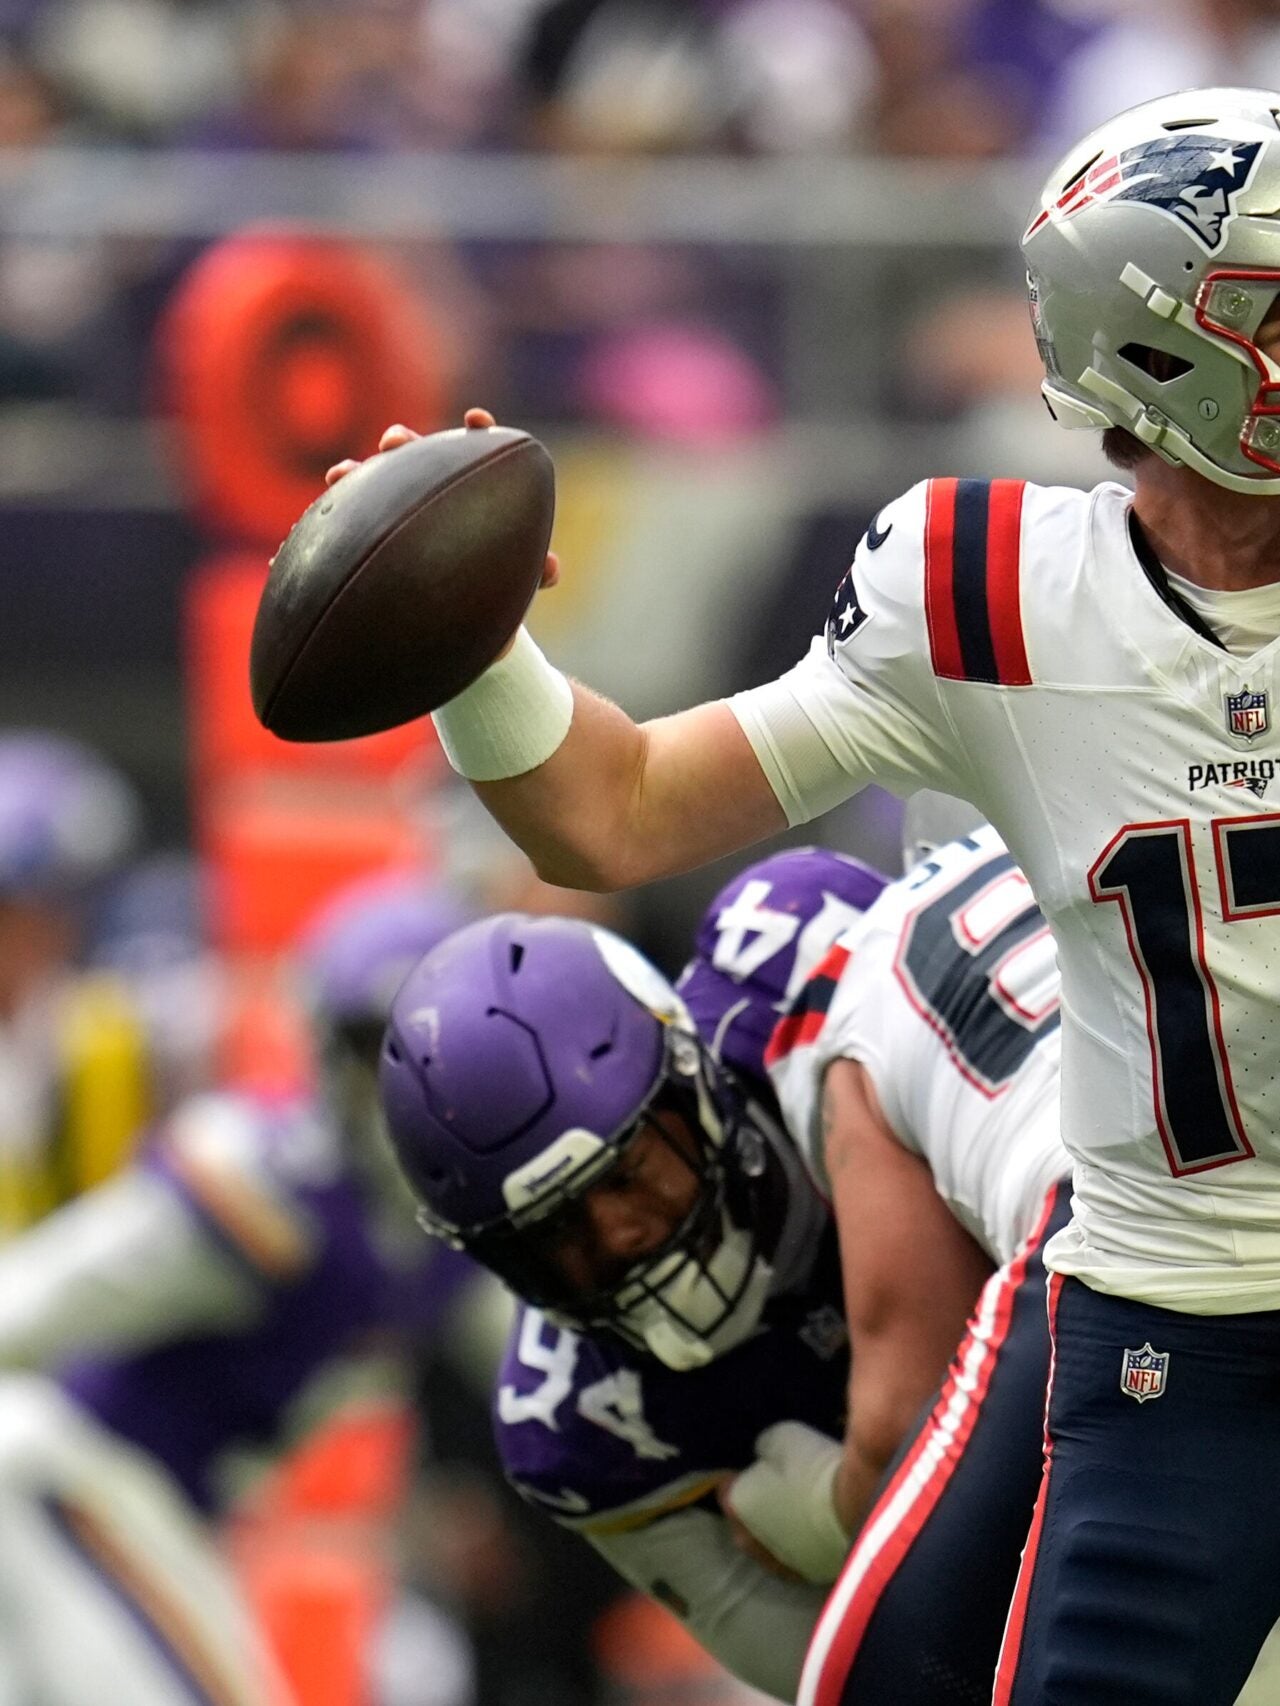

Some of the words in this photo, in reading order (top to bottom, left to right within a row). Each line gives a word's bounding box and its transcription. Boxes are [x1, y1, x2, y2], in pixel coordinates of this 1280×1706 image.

[1233, 711, 1264, 732] NFL
[892, 848, 1062, 1100] 6
[498, 1306, 681, 1461] 94
[1128, 1371, 1158, 1393] NFL
